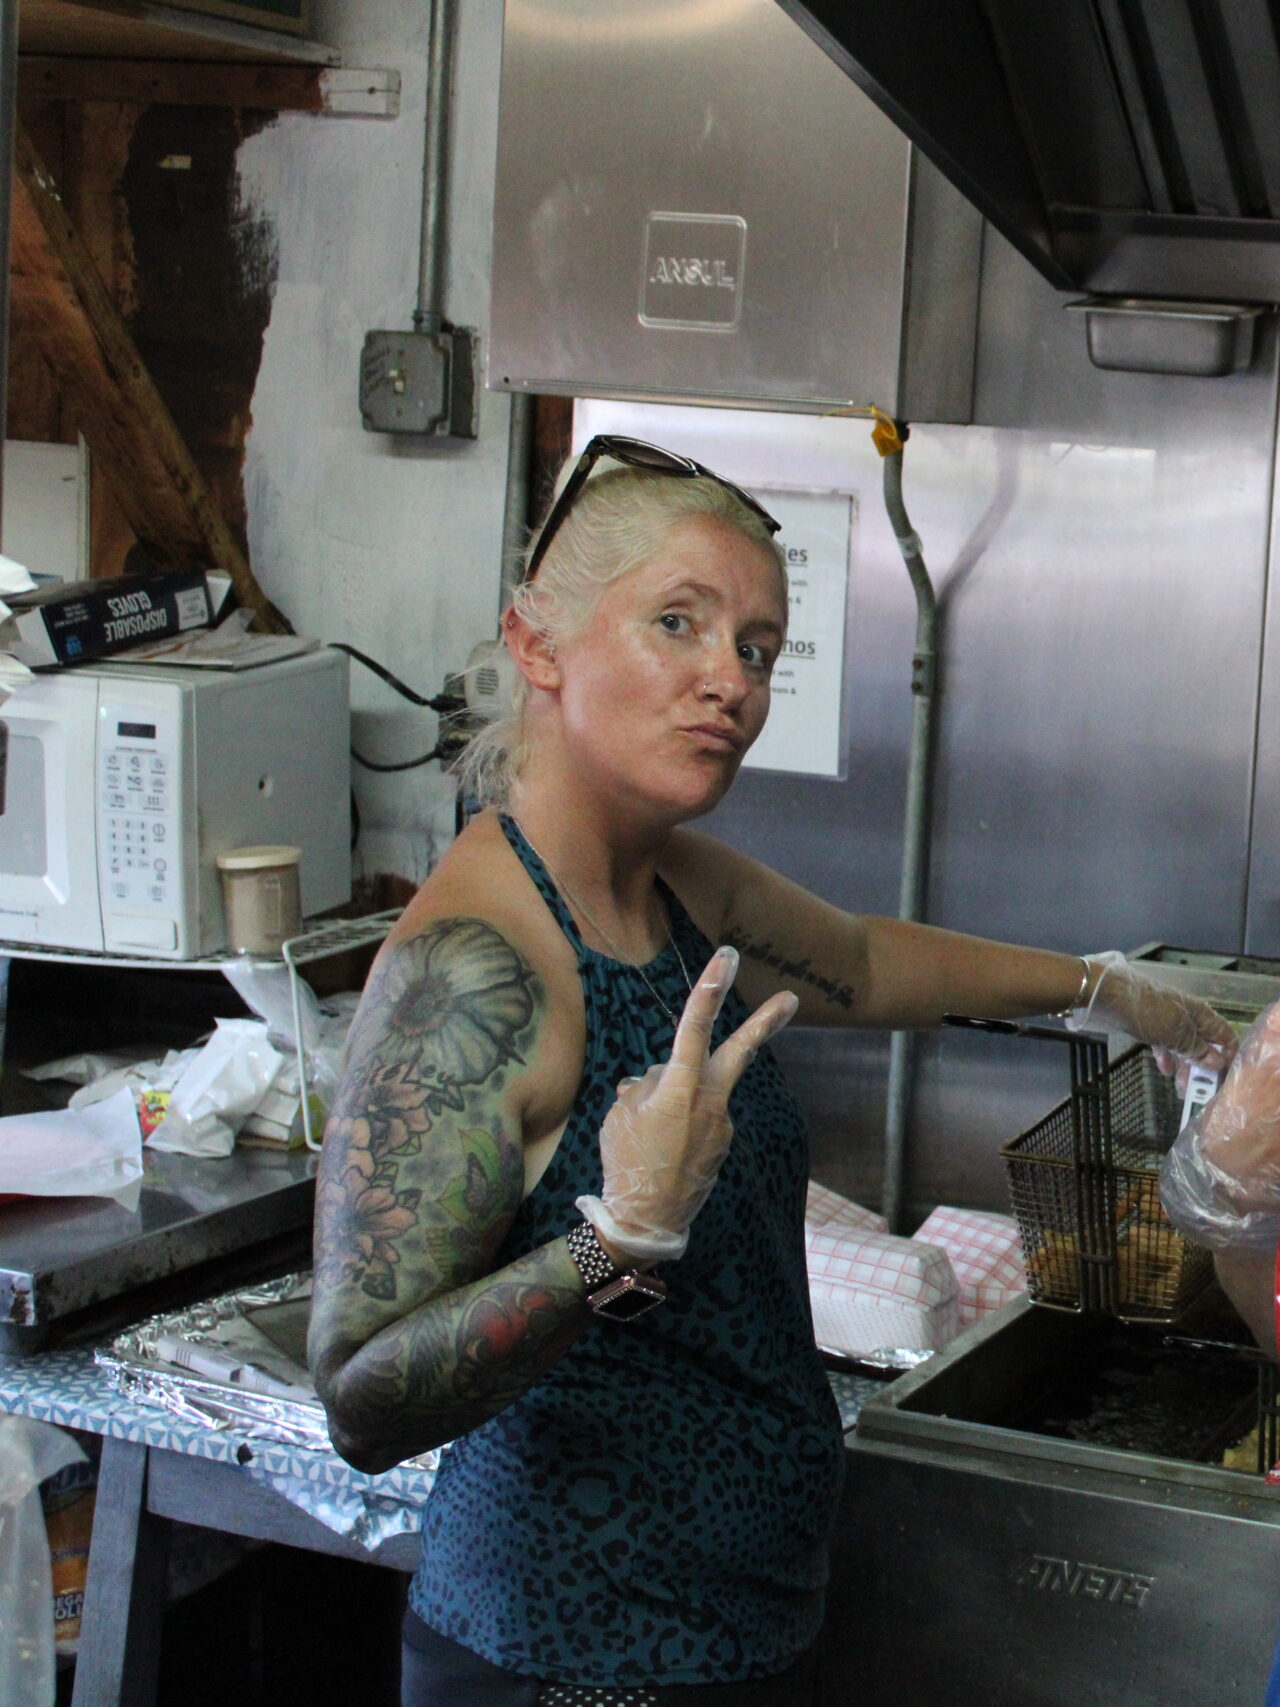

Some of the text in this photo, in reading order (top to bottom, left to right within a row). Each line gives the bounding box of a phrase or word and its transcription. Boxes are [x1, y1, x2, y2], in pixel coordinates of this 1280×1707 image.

[650, 257, 735, 291] ANSUL
[107, 591, 152, 617] GLOVES
[104, 608, 167, 642] DISPOSABLE
